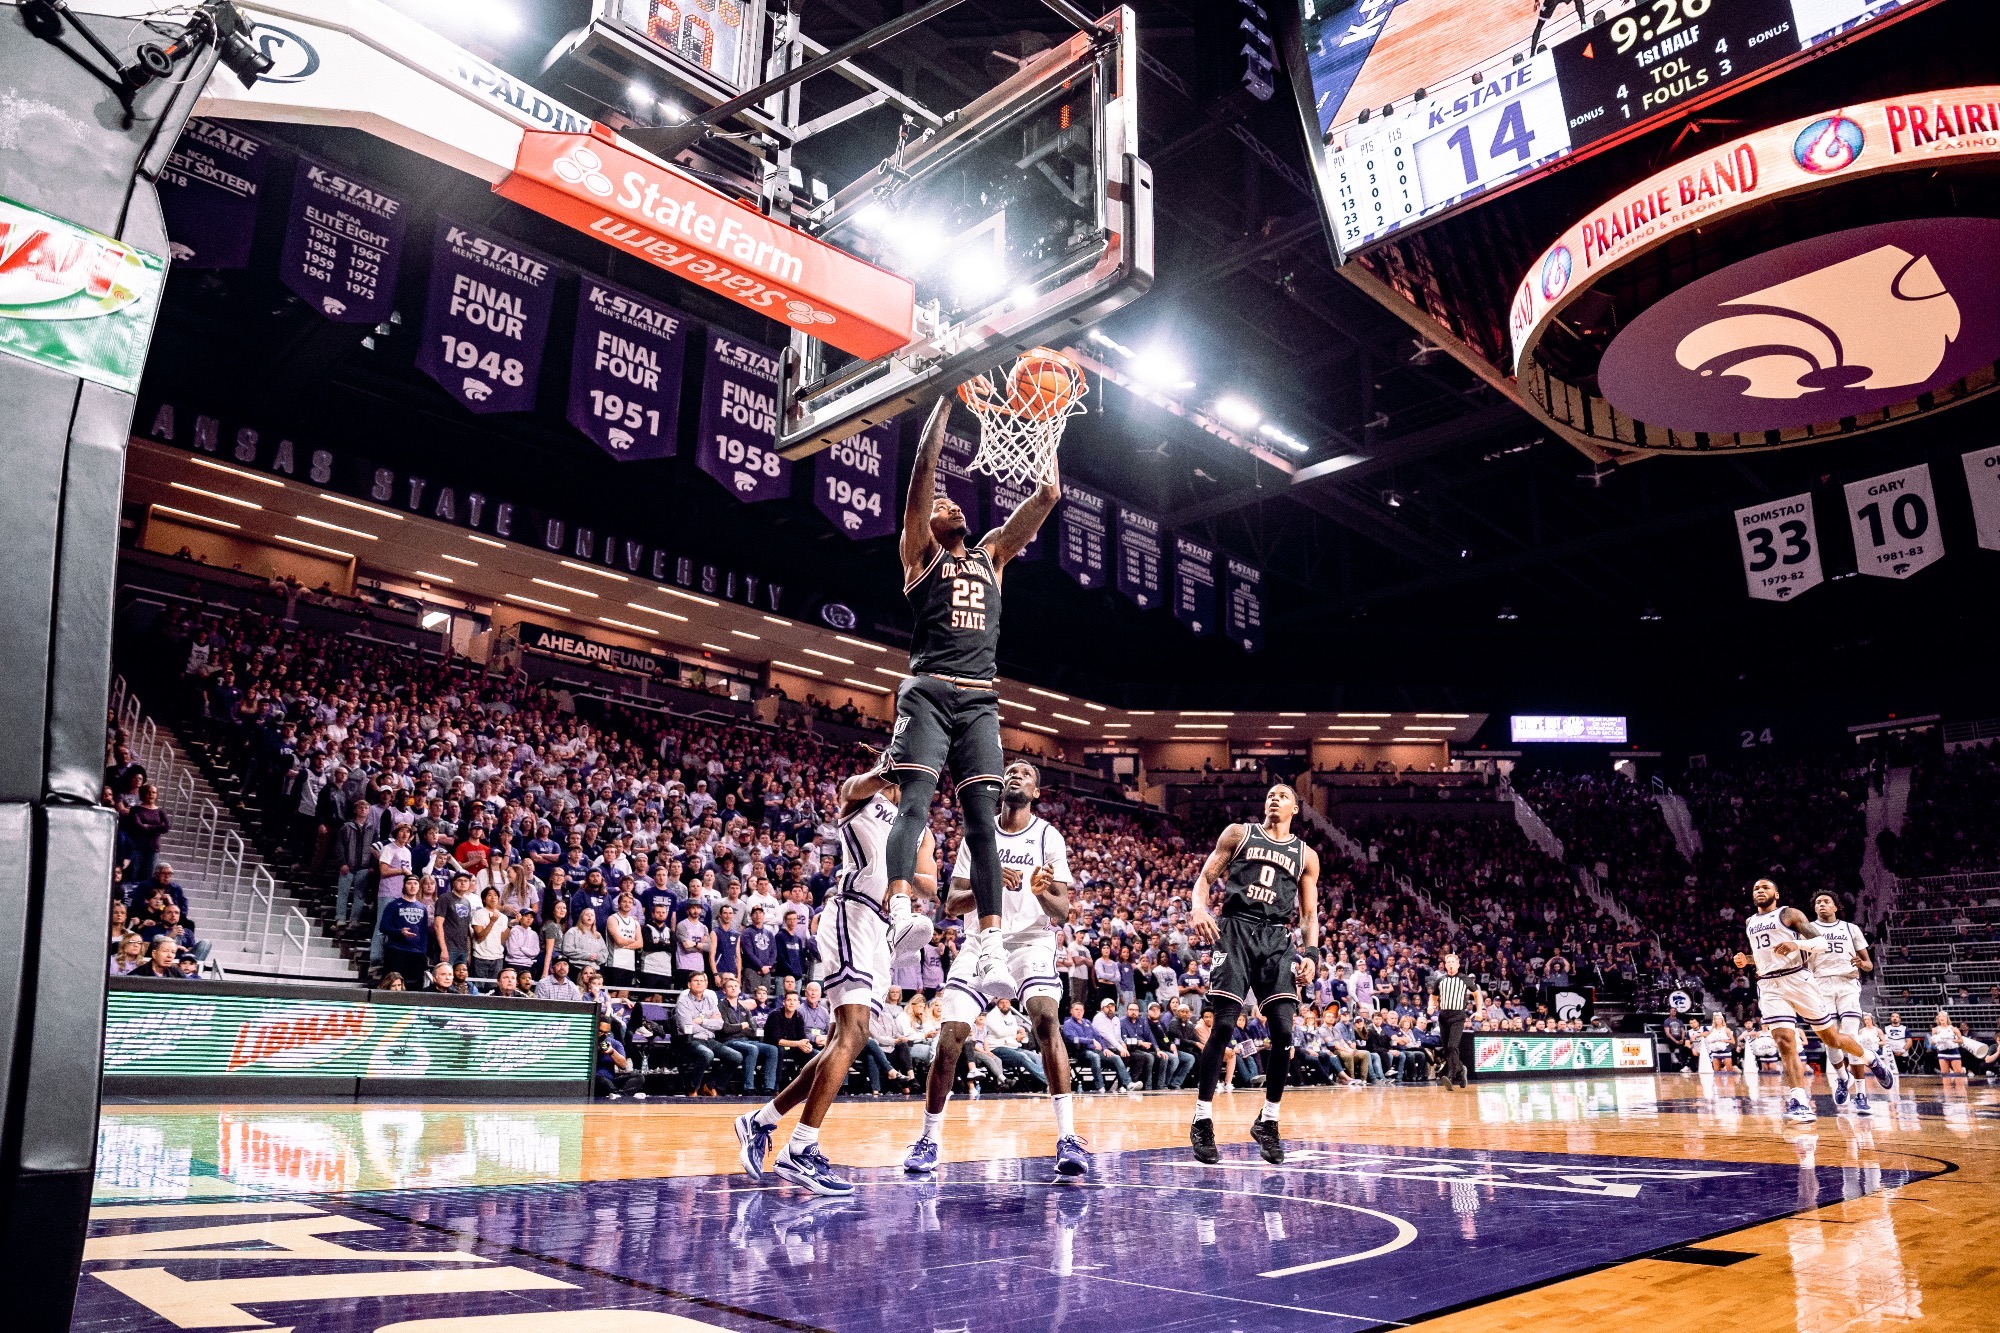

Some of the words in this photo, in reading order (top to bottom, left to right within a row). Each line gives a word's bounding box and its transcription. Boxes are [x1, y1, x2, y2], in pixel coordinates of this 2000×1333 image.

[1635, 44, 1662, 68] 1st
[1662, 25, 1700, 58] HALF
[1748, 21, 1790, 48] BONUS
[1616, 84, 1629, 100] 4
[1650, 57, 1690, 84] TOL
[1714, 38, 1728, 54] 4
[449, 50, 588, 133] PALDIN
[1428, 63, 1535, 130] K-STATE
[1620, 104, 1631, 119] 1
[1642, 68, 1709, 110] FOULS
[1719, 59, 1732, 76] 3
[1569, 106, 1605, 128] BONUS
[1885, 103, 2000, 155] PRAIRI
[184, 118, 259, 156] STATE
[1361, 142, 1374, 156] PTS
[1388, 128, 1402, 143] FLS
[1447, 100, 1535, 184] 14
[1934, 137, 1998, 151] CASINO
[169, 152, 194, 169] EET
[194, 162, 257, 195] SIXTEEN
[187, 149, 216, 166] NCAA
[1340, 172, 1347, 183] 5
[1366, 160, 1374, 171] 0
[1394, 146, 1402, 157] 0
[160, 170, 188, 187] 018
[307, 166, 400, 215] K-STATE
[1339, 185, 1352, 197] 11
[1369, 173, 1376, 184] 3
[1397, 160, 1404, 171] 0
[1341, 199, 1356, 211] 13
[1371, 187, 1379, 198] 0
[1399, 174, 1407, 185] 0
[337, 210, 361, 226] NCAA
[340, 193, 391, 220] BASKETBALL
[1344, 213, 1358, 226] 23
[1374, 201, 1382, 212] 0
[1403, 189, 1408, 199] 1
[1346, 226, 1361, 240] 35
[1377, 215, 1385, 227] 2
[1404, 203, 1412, 214] 0
[1581, 185, 1672, 270] PRAIRIE
[1678, 142, 1759, 208] BAND
[306, 205, 344, 231] ELITE
[346, 223, 389, 248] EIGHT
[309, 226, 337, 246] 1951
[352, 244, 381, 263] 1964
[304, 251, 334, 270] 1959
[348, 269, 377, 287] 1973
[307, 238, 336, 258] 1958
[350, 256, 379, 275] 1972
[446, 226, 549, 281] K-STATE
[452, 246, 480, 263] MEN'S
[483, 258, 539, 287] BASKETBALL
[302, 263, 331, 283] 1961
[346, 281, 375, 300] 1975
[453, 273, 527, 320] FINAL
[450, 295, 523, 341] FOUR
[588, 286, 680, 335] K-STATE
[595, 304, 620, 320] MEN'S
[622, 315, 671, 341] BASKETBALL
[441, 335, 523, 387] 1948
[597, 330, 662, 373] FINAL
[714, 338, 780, 376] K-STAT
[719, 354, 741, 369] MEN'S
[743, 364, 778, 384] BASKETBA
[595, 350, 659, 392] FOUR
[590, 389, 660, 437] 1951
[722, 379, 777, 417] FINAL
[721, 398, 776, 436] FOUR
[716, 435, 781, 477] 1958
[830, 444, 880, 477] FOUR
[943, 432, 972, 452] TATE
[826, 476, 882, 517] 1964
[1022, 485, 1032, 495] 12
[1062, 484, 1104, 509] K-STATE
[1868, 478, 1906, 497] GARY
[151, 404, 333, 484] ANSAS
[371, 467, 515, 538] STATE
[546, 517, 783, 611] UNIVERSITY
[1120, 508, 1159, 532] K-STATE
[1742, 503, 1805, 526] ROMSTAD
[1857, 493, 1929, 547] 10
[1177, 538, 1213, 562] K-STATE
[1746, 519, 1812, 573] 33
[1876, 546, 1924, 564] 1981-83
[1228, 559, 1261, 581] K-STATE
[1761, 571, 1805, 587] 1979-82
[952, 578, 985, 609] 22
[951, 611, 986, 631] STATE
[998, 849, 1035, 867] ldcats
[1245, 846, 1296, 877] OKLAHOMA
[1259, 865, 1276, 888] 0
[1246, 884, 1278, 905] STATE
[1749, 921, 1776, 935] Wildcats
[1755, 933, 1771, 949] 13
[1825, 942, 1844, 954] 35
[226, 1005, 367, 1072] LIBMAN
